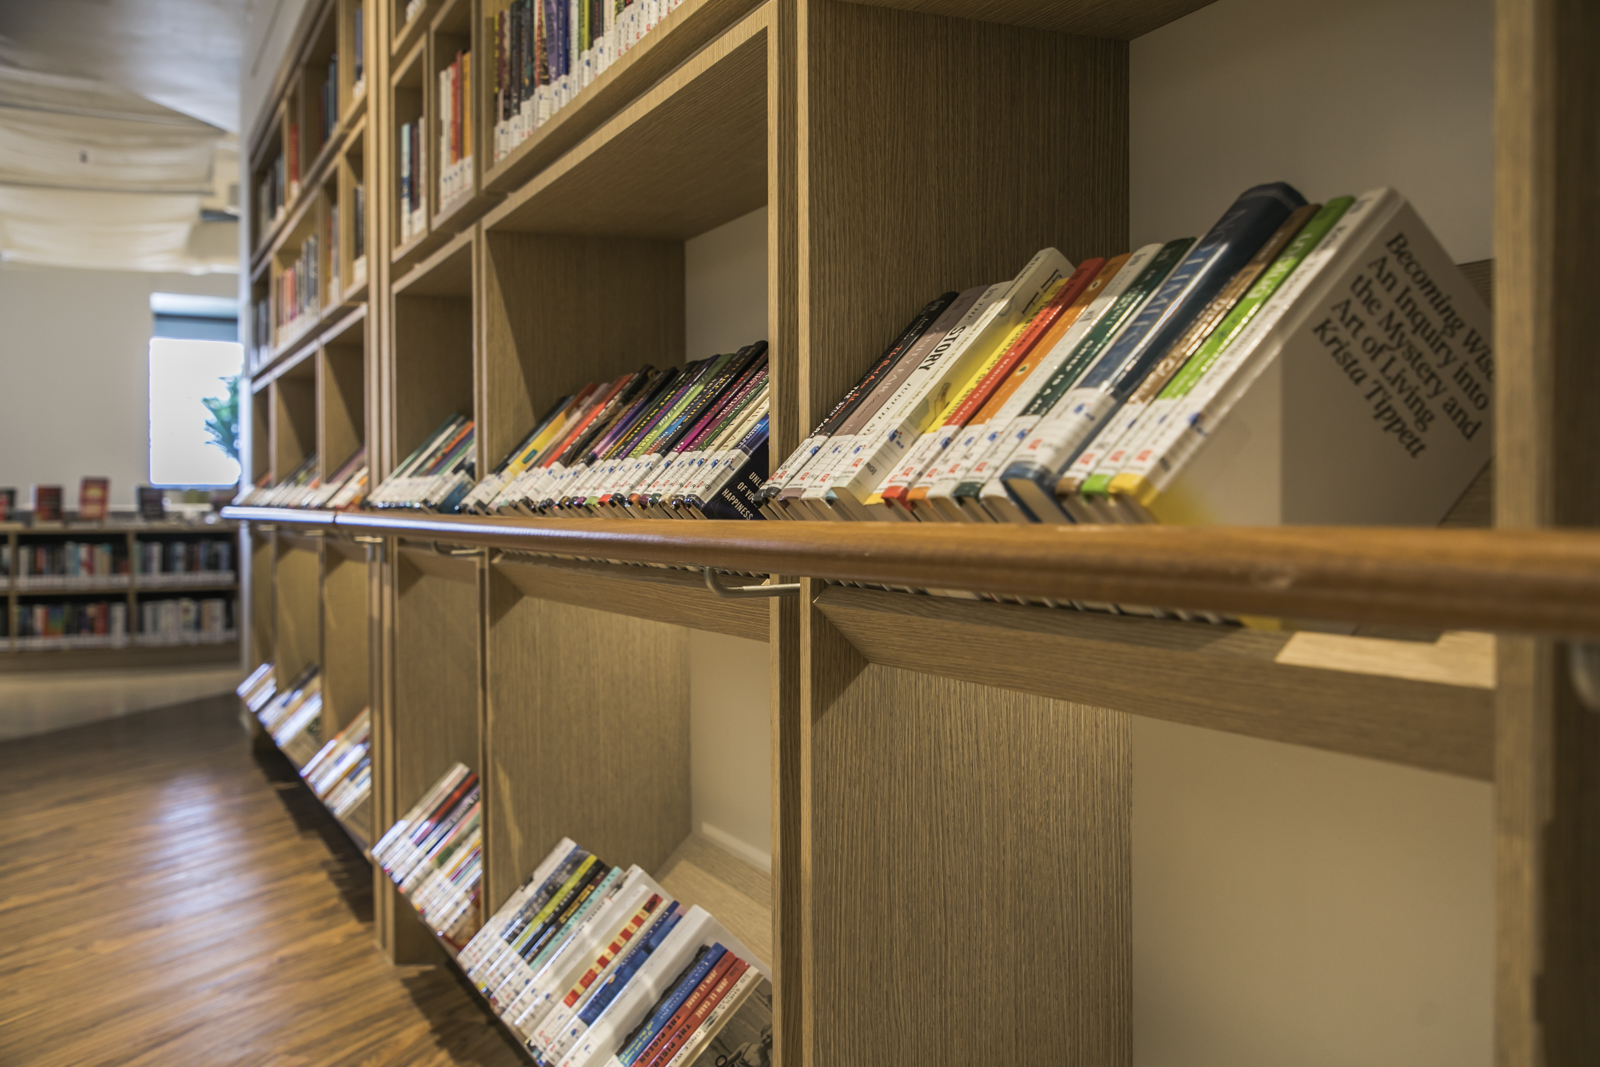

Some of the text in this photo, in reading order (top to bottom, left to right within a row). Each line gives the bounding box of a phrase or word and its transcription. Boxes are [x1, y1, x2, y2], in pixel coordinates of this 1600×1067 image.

[1385, 232, 1465, 338] Becoming
[905, 327, 940, 364] VANITY
[919, 301, 984, 371] THE STORY
[987, 319, 1032, 370] GEOGRAPHY
[1367, 256, 1489, 411] An Inquiry into
[1065, 340, 1093, 372] GRIEF
[1331, 299, 1435, 432] Art of Living
[1350, 275, 1482, 441] the Mystery and
[878, 369, 902, 393] FAIR
[973, 359, 1009, 398] MANIFESTO
[1312, 318, 1427, 458] Krista Tippett
[878, 383, 911, 420] JUDITH
[944, 388, 974, 420] GENIUS
[737, 482, 748, 492] OF
[721, 488, 753, 520] HAPPINESS
[621, 911, 668, 968] PAT CONROY
[705, 970, 717, 984] JOHN
[716, 978, 729, 993] JOHN
[685, 992, 700, 1009] CARRÉ
[696, 1000, 711, 1018] CARRÉ
[720, 988, 740, 1010] SHEILA
[666, 1015, 680, 1030] THE
[676, 1024, 691, 1040] THE
[639, 1032, 666, 1063] PIGEON
[684, 1031, 701, 1052] ONCE
